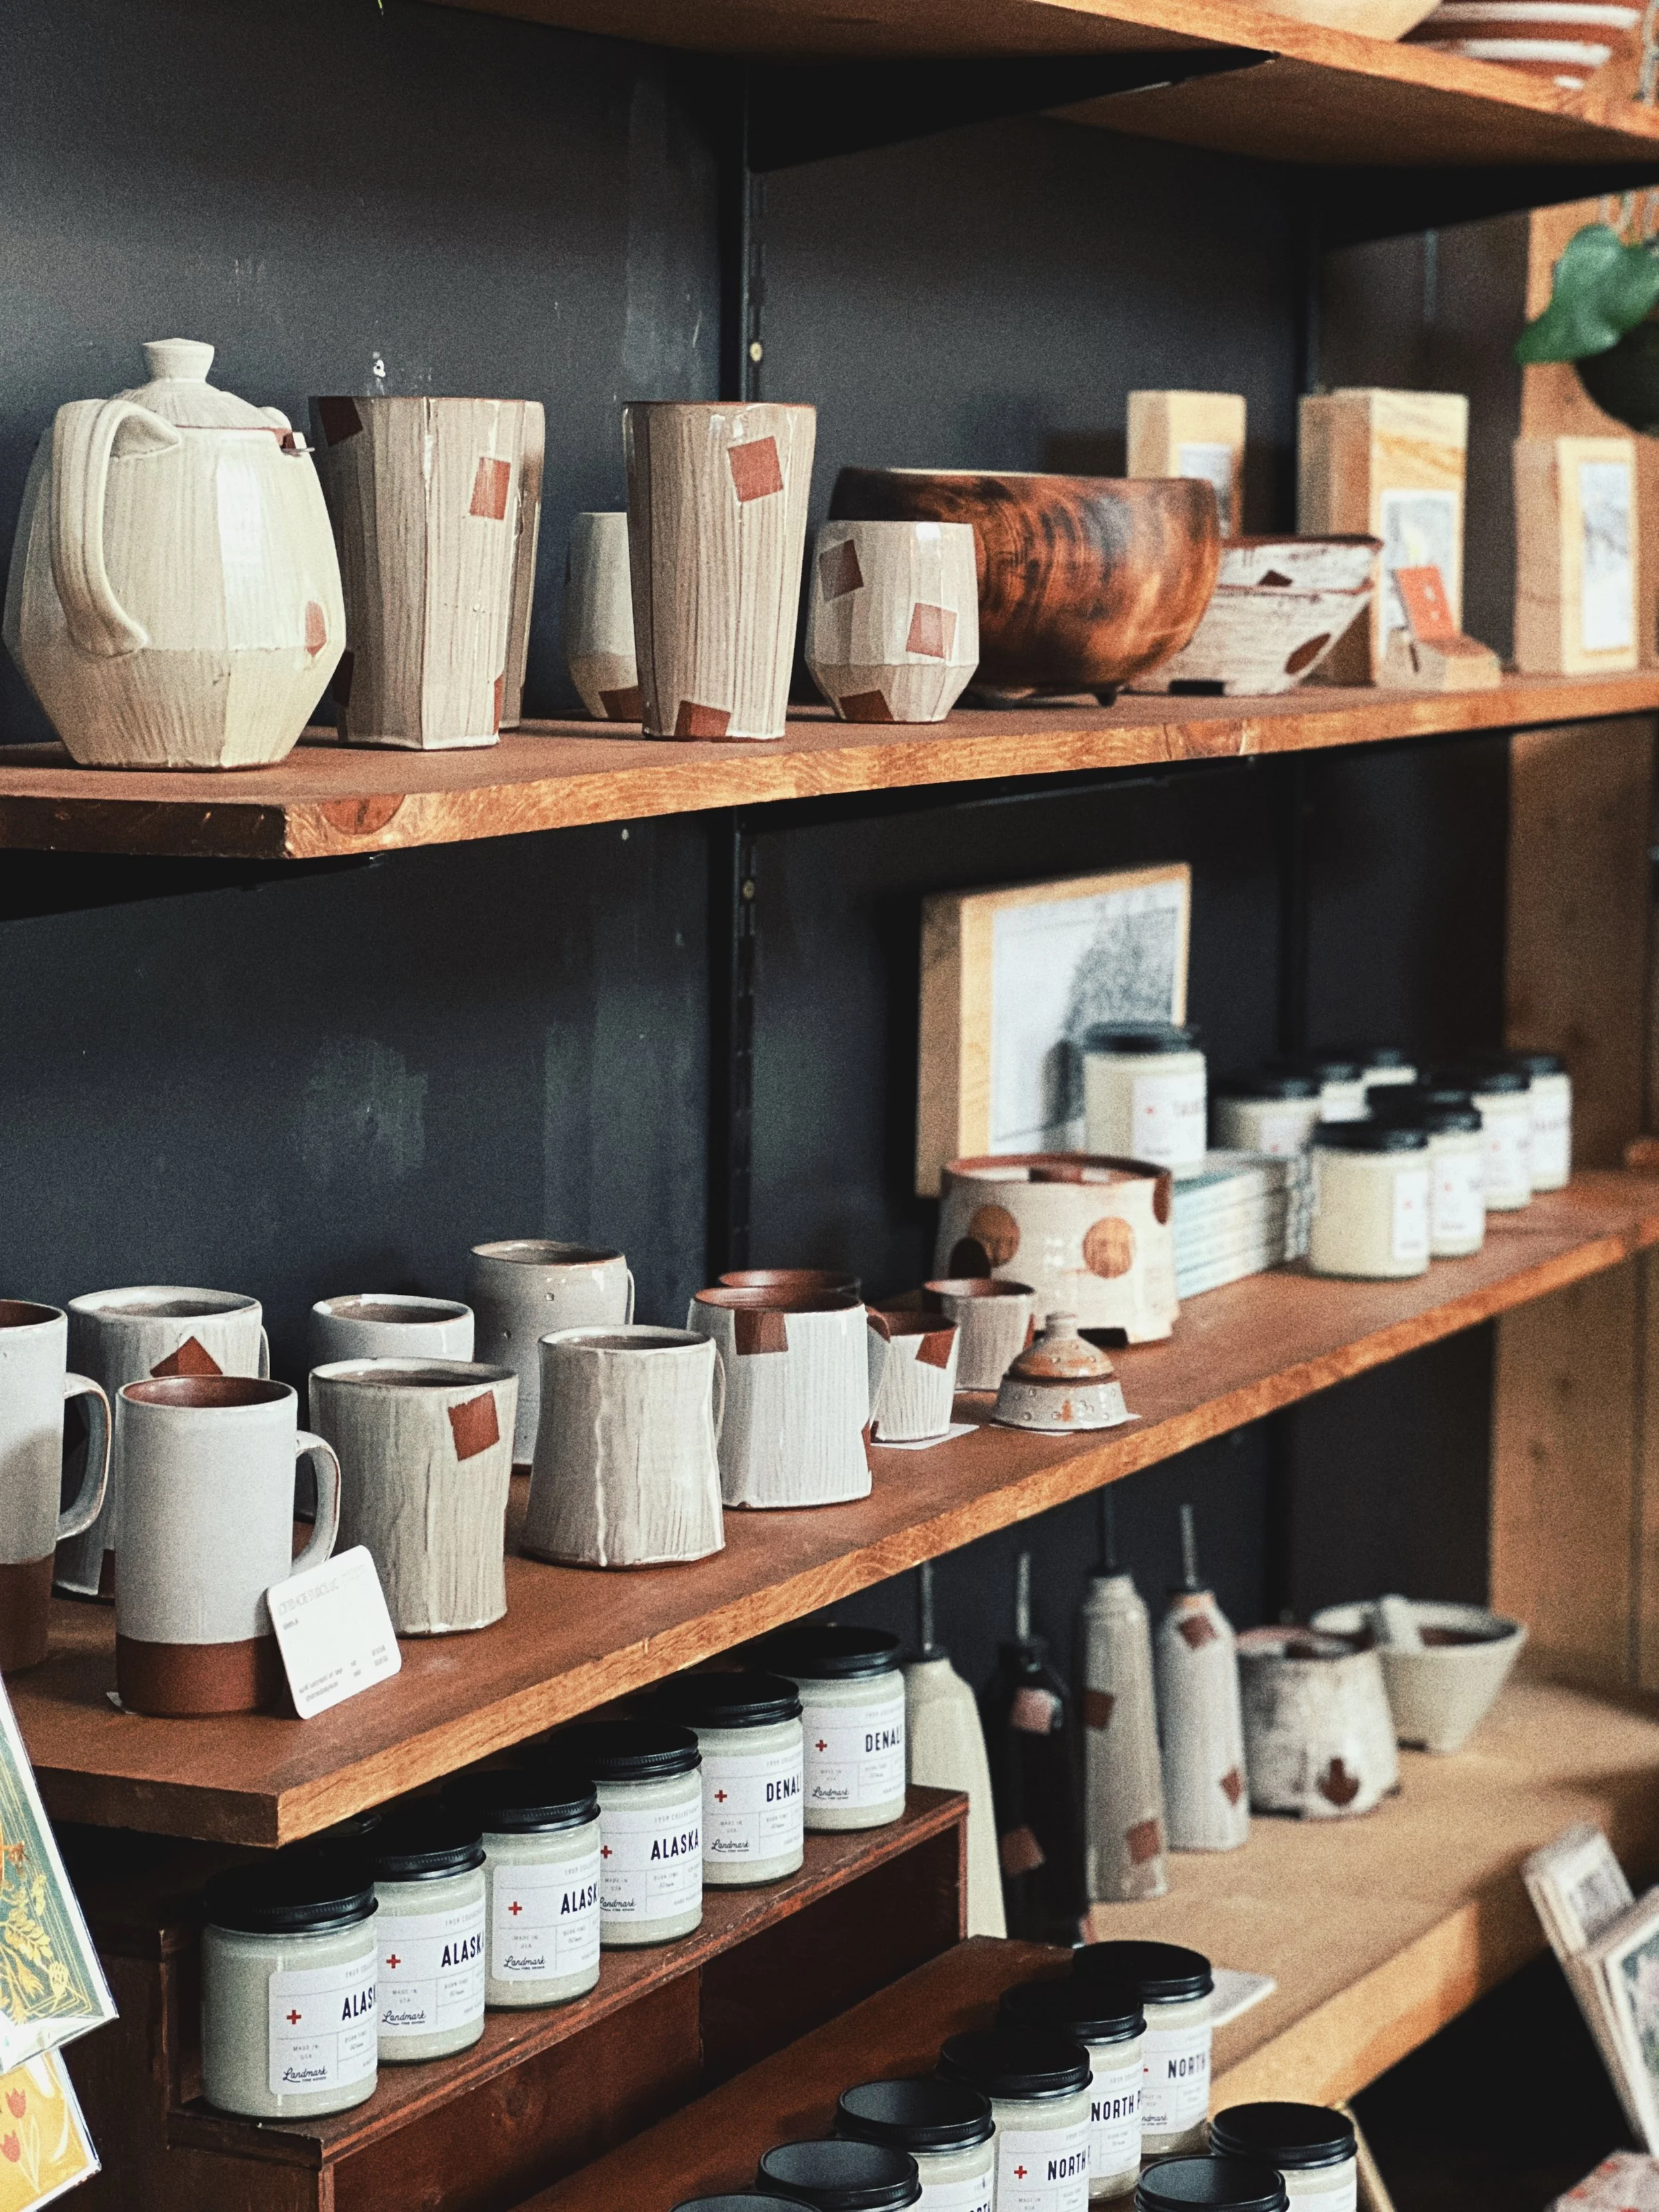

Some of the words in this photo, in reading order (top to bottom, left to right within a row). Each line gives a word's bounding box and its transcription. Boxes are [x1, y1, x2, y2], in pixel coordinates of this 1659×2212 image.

[812, 1786, 849, 1800] Landmark
[650, 1828, 699, 1861] ALASKA
[711, 1838, 750, 1853] Landmark
[504, 1954, 545, 1970] Landmark
[382, 2010, 426, 2025] Landmark
[283, 2066, 328, 2083] Landmark
[1091, 2094, 1134, 2122] NORTH
[1141, 2114, 1168, 2122] ndmark
